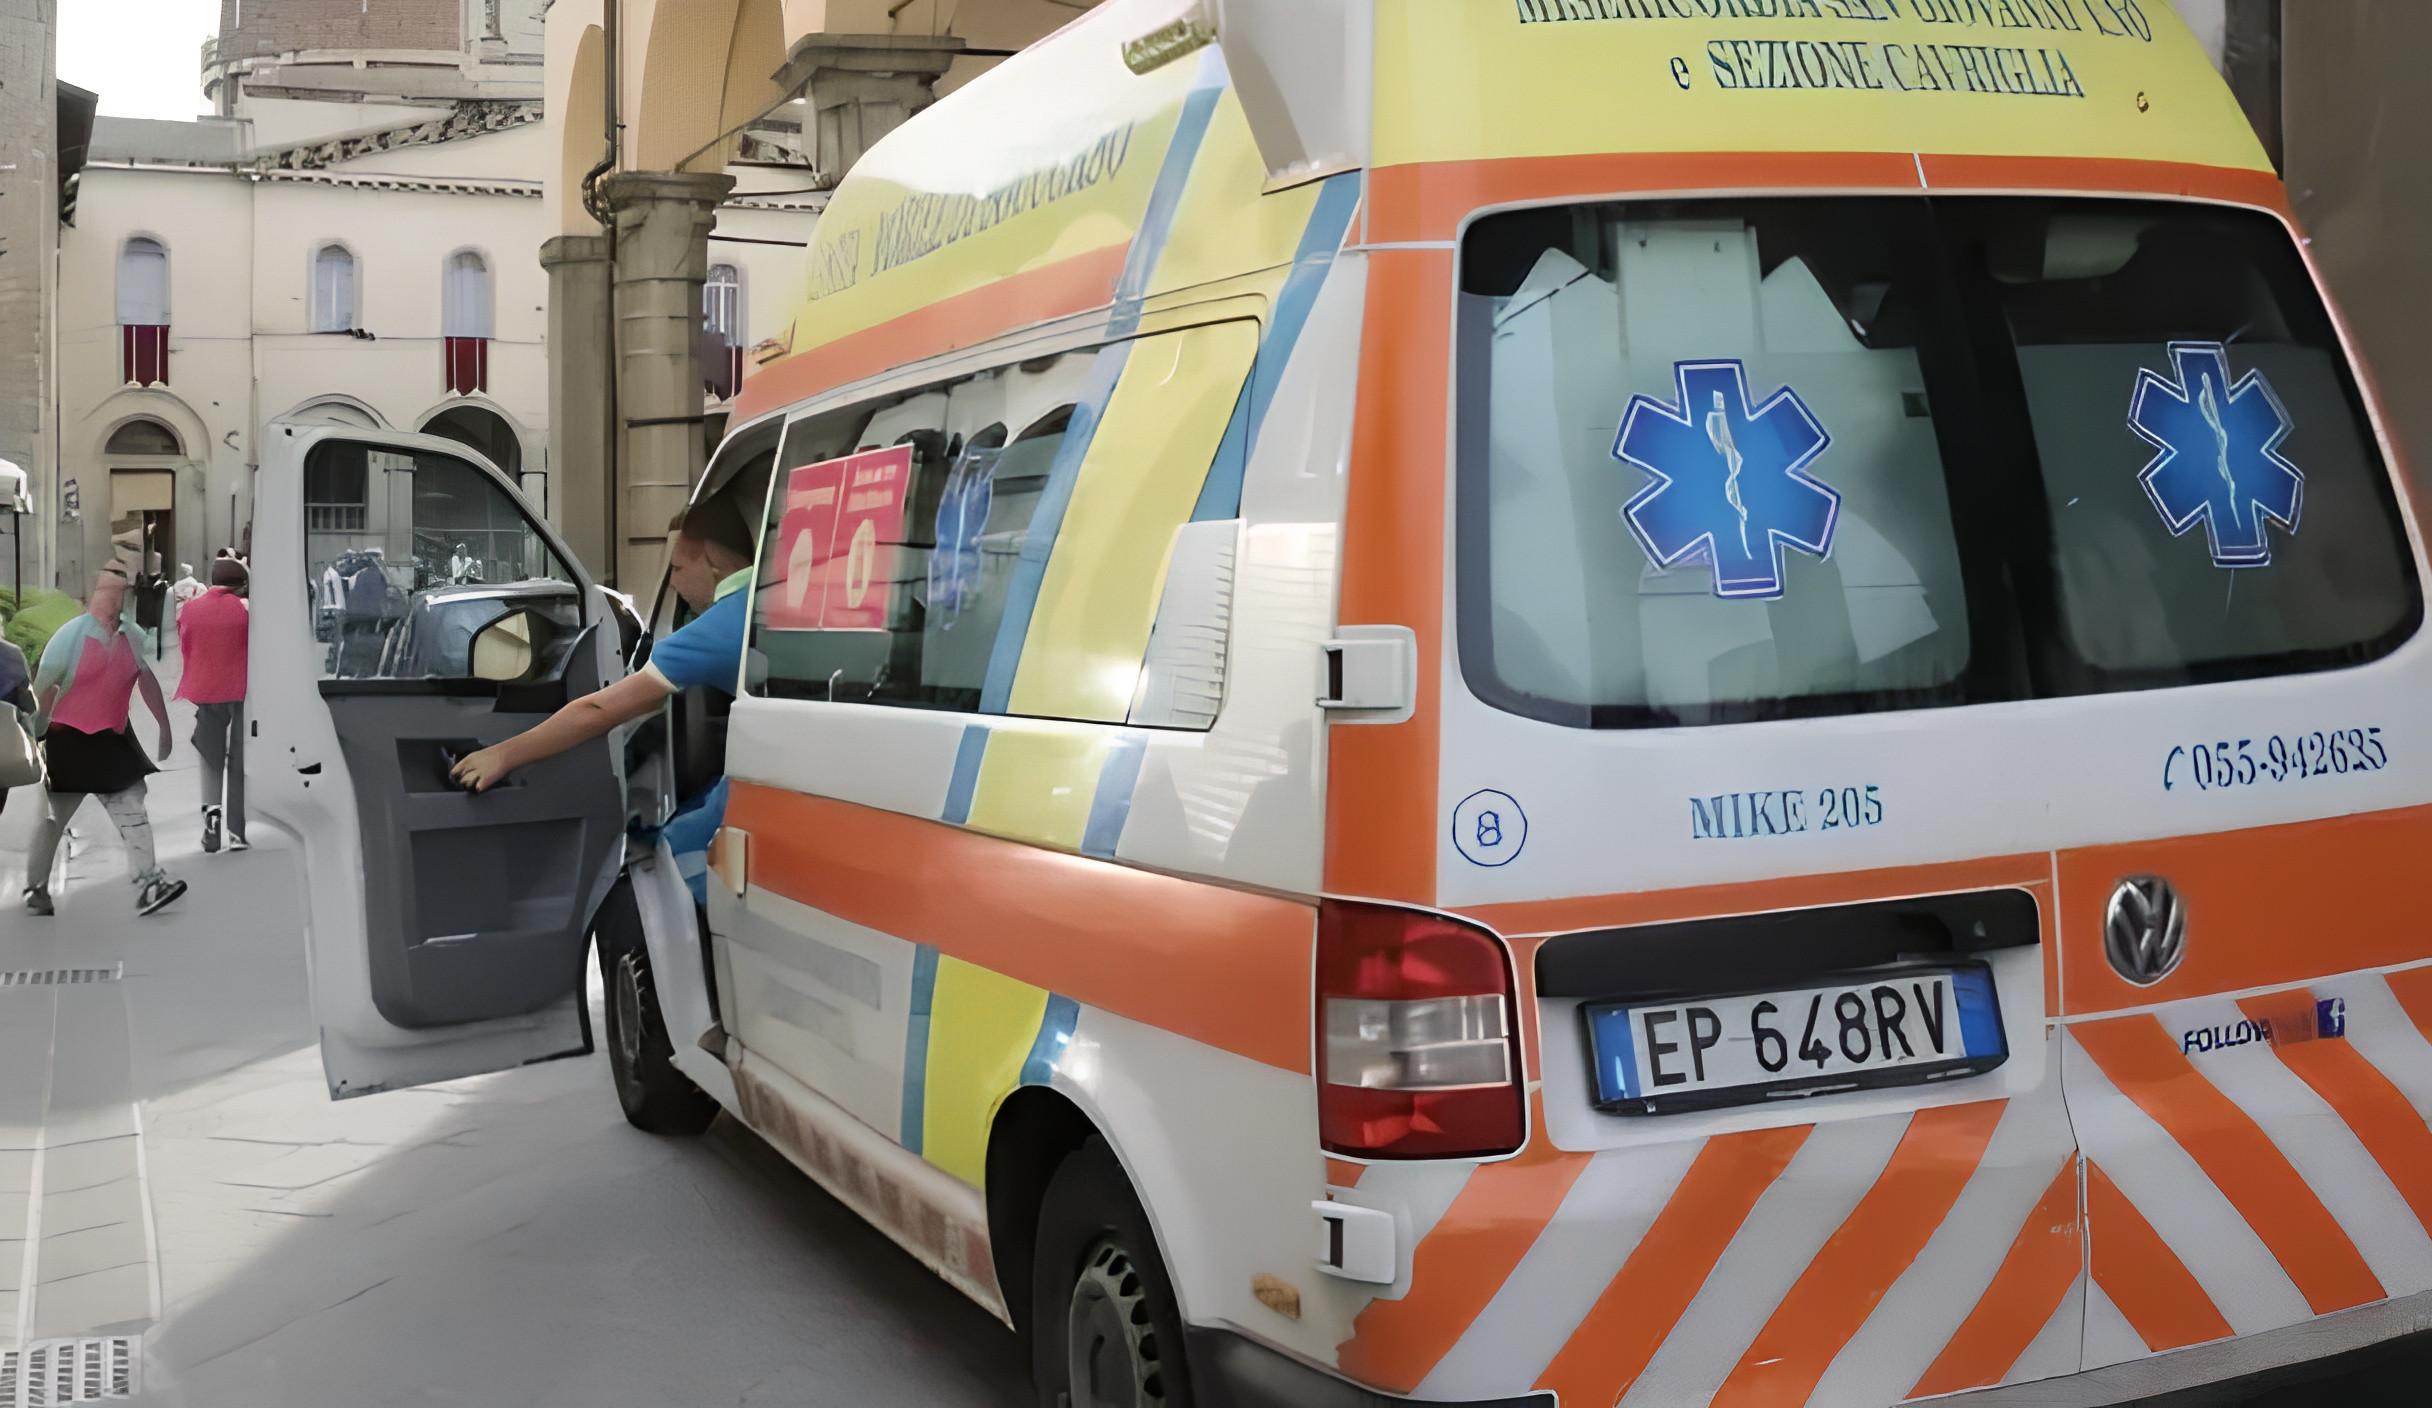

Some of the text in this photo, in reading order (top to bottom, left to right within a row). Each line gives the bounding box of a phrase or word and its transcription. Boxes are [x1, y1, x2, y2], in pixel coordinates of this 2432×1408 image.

[1670, 56, 1690, 90] e
[1707, 40, 1883, 89] SEZIONE
[1477, 811, 1502, 847] 8
[1689, 784, 1883, 839] MIKE 205
[1643, 980, 1944, 1087] EP 648RV
